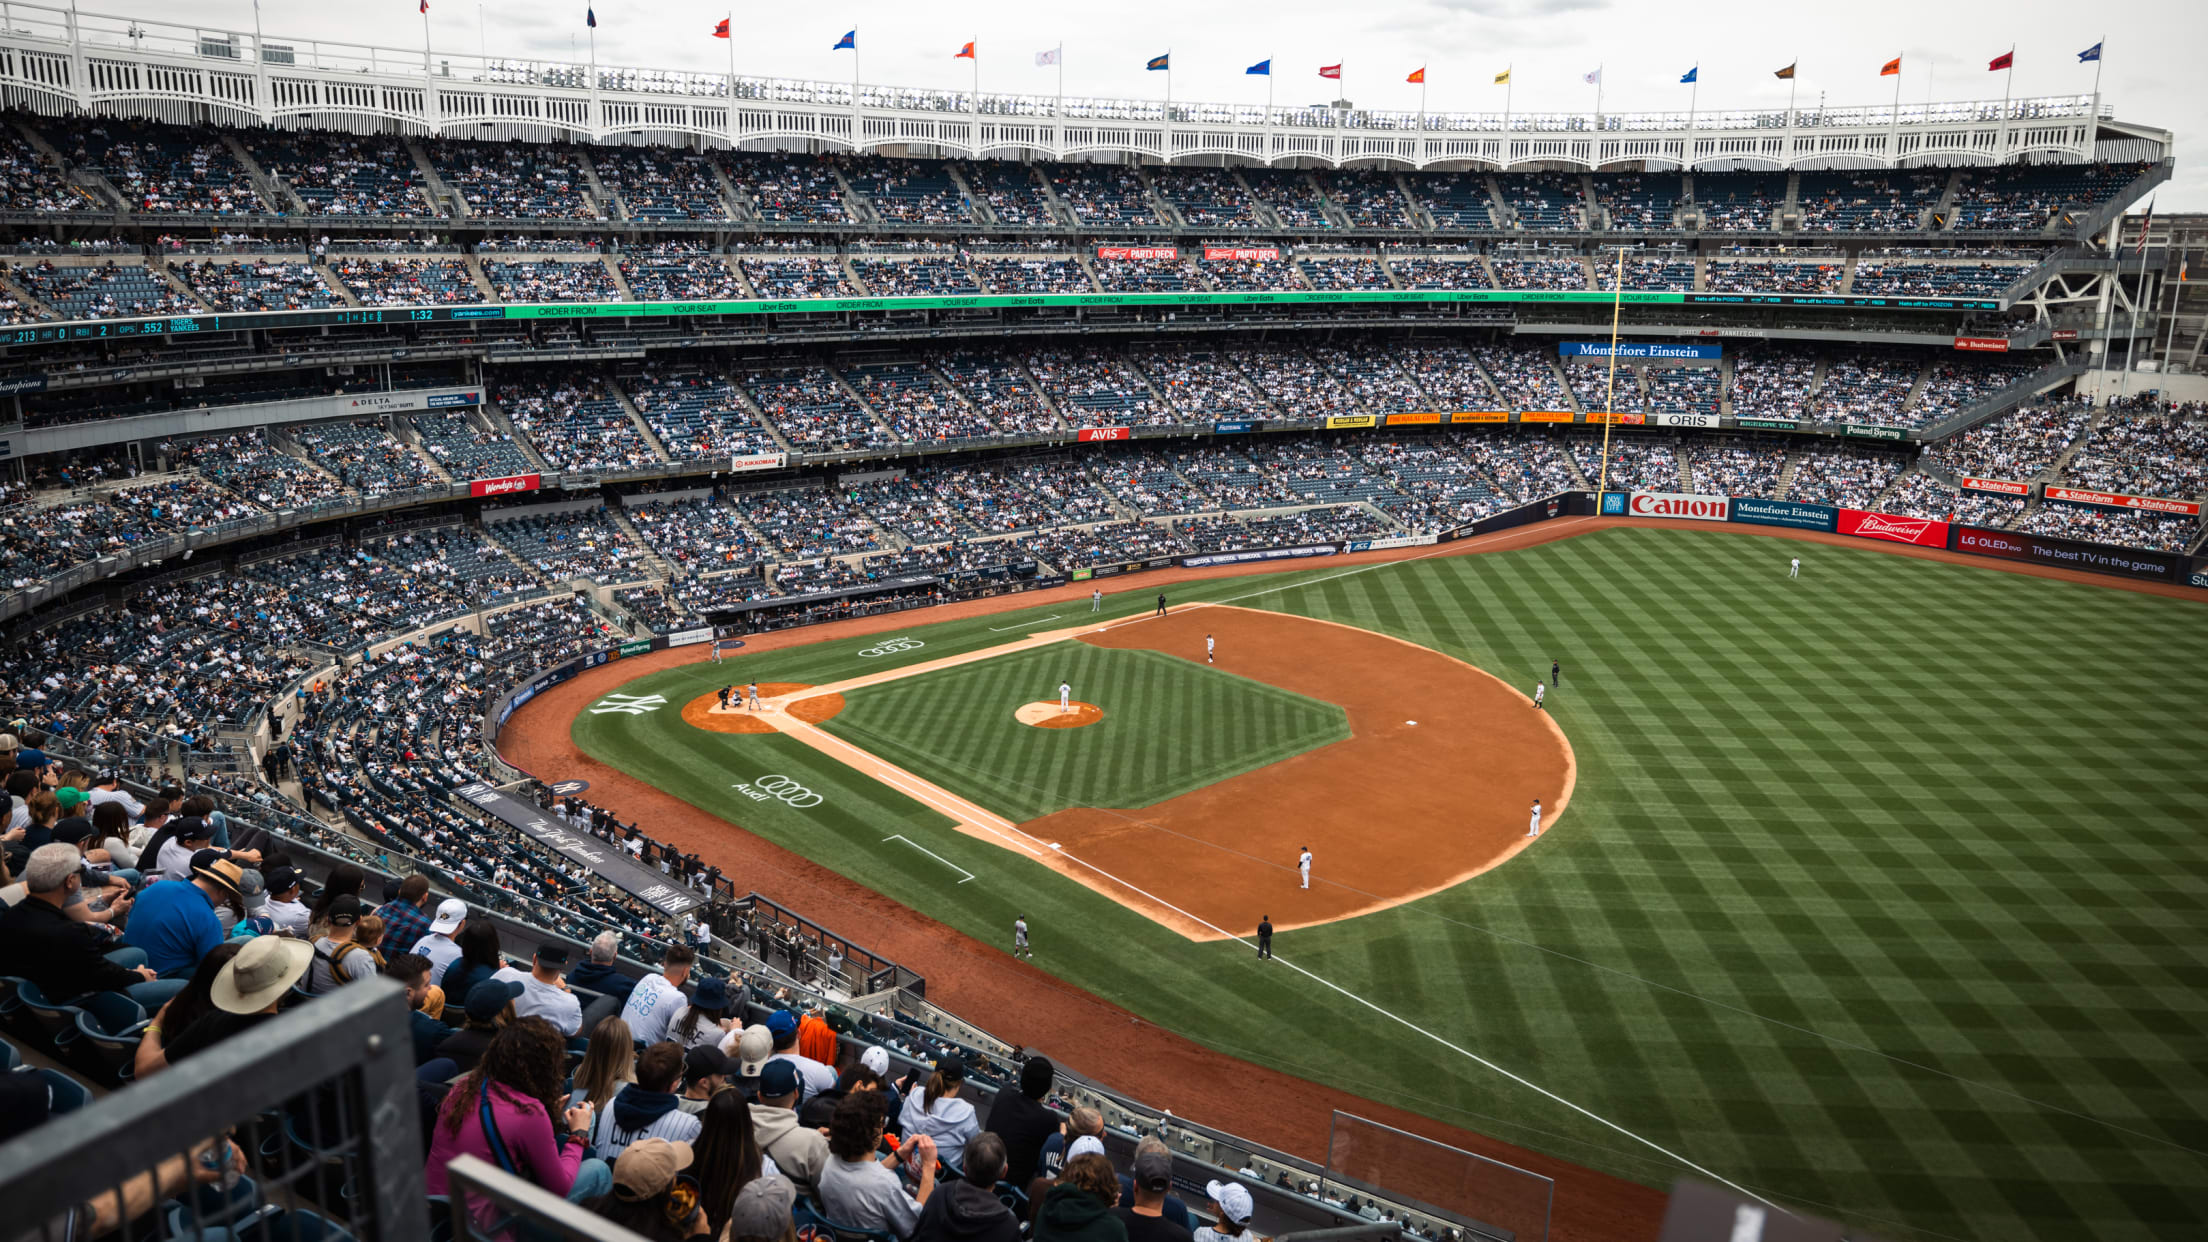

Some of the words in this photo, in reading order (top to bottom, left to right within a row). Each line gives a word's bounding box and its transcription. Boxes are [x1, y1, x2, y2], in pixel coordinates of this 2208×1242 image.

[1131, 248, 1153, 259] PARTY
[1155, 248, 1175, 259] DECK
[1235, 249, 1257, 260] PARTY
[1259, 249, 1277, 260] DECK
[1011, 297, 1027, 305] Uber
[1028, 297, 1045, 305] Eats
[1104, 296, 1123, 304] FROM
[1178, 295, 1196, 303] YOUR
[673, 305, 696, 313] YOUR
[697, 304, 717, 312] SEAT
[758, 303, 777, 311] Uber
[779, 303, 797, 311] Eats
[862, 301, 883, 309] FROM
[410, 310, 433, 320] 1:32
[453, 308, 500, 318] yankees.com
[538, 307, 570, 316] ORDER
[571, 306, 597, 315] FROM
[170, 318, 194, 326] TIGERS
[15, 330, 36, 343] .213
[58, 328, 65, 339] 0
[76, 328, 90, 337] RBI
[100, 325, 107, 336] 2
[119, 325, 135, 334] OPS
[141, 322, 162, 334] .552
[170, 323, 200, 333] YANKEES
[1580, 343, 1646, 356] Montefiore
[1650, 345, 1699, 357] Einstein
[1970, 341, 2006, 350] Budweiser
[361, 397, 390, 406] DELTA
[1669, 415, 1707, 426] ORIS
[1740, 420, 1776, 429] BIGELOW
[1778, 422, 1795, 430] TEA
[1090, 428, 1118, 440] AVIS
[1847, 425, 1873, 435] Poland
[1874, 427, 1900, 439] Spring
[744, 458, 777, 467] KIKKOMAN
[485, 480, 513, 495] Wendy's
[1631, 494, 1726, 518] Canon
[1738, 502, 1790, 515] Montefiore
[1792, 507, 1829, 519] Einstein
[1865, 518, 1922, 537] Budweiser
[1352, 542, 1369, 550] ACC
[1961, 535, 1976, 546] LG
[1979, 537, 2008, 550] OLED
[2008, 544, 2022, 552] evo
[2032, 545, 2051, 558] The
[2054, 547, 2078, 562] best
[2081, 552, 2097, 562] TV
[2098, 554, 2108, 565] in
[2111, 557, 2129, 568] the
[2131, 561, 2165, 573] game
[2191, 575, 2208, 587] Stu
[731, 783, 771, 802] Audi
[526, 818, 551, 832] New
[557, 838, 605, 864] Yankees
[672, 1019, 704, 1045] JUGE
